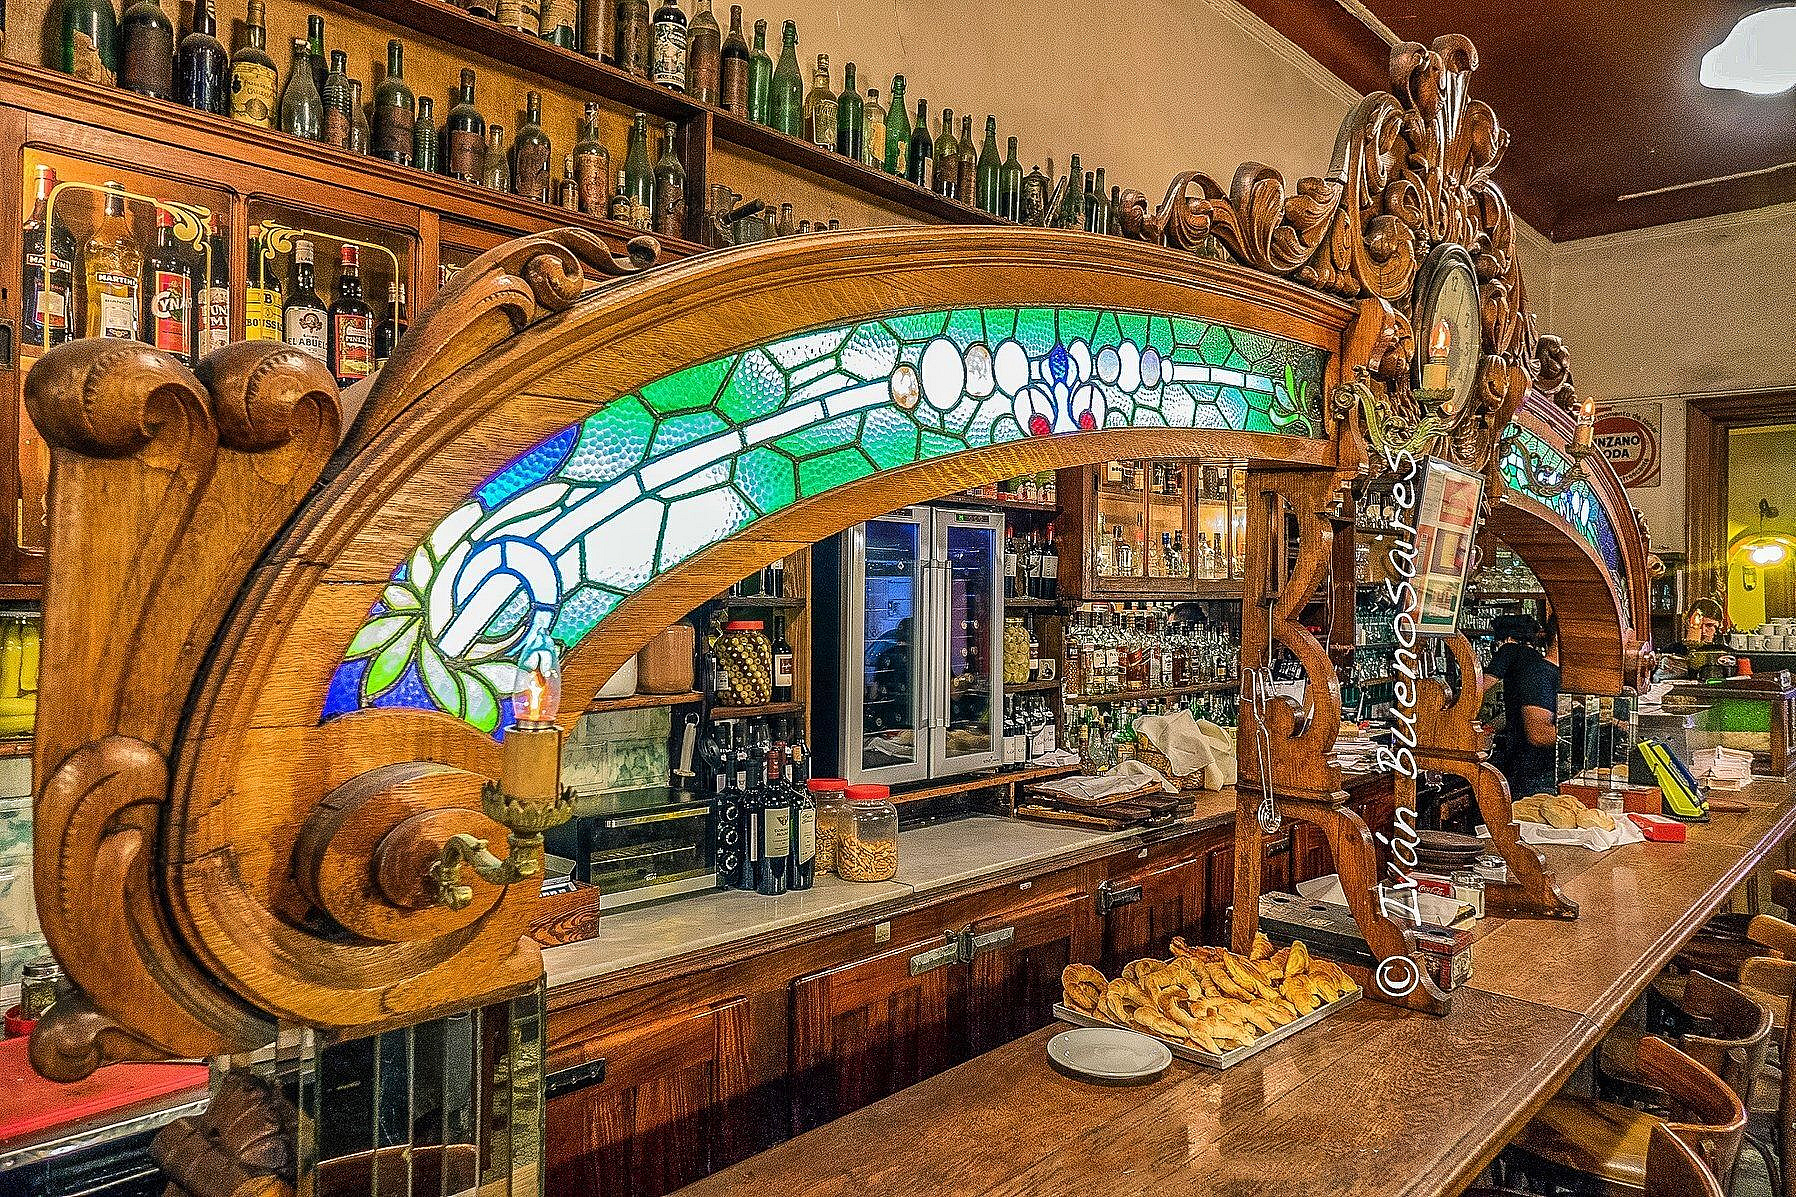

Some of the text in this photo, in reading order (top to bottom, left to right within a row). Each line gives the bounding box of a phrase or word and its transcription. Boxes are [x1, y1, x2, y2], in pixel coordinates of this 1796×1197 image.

[29, 255, 70, 270] MATINI
[97, 274, 138, 287] MARTINI
[1593, 436, 1640, 447] INZANO
[1604, 448, 1630, 459] ODA
